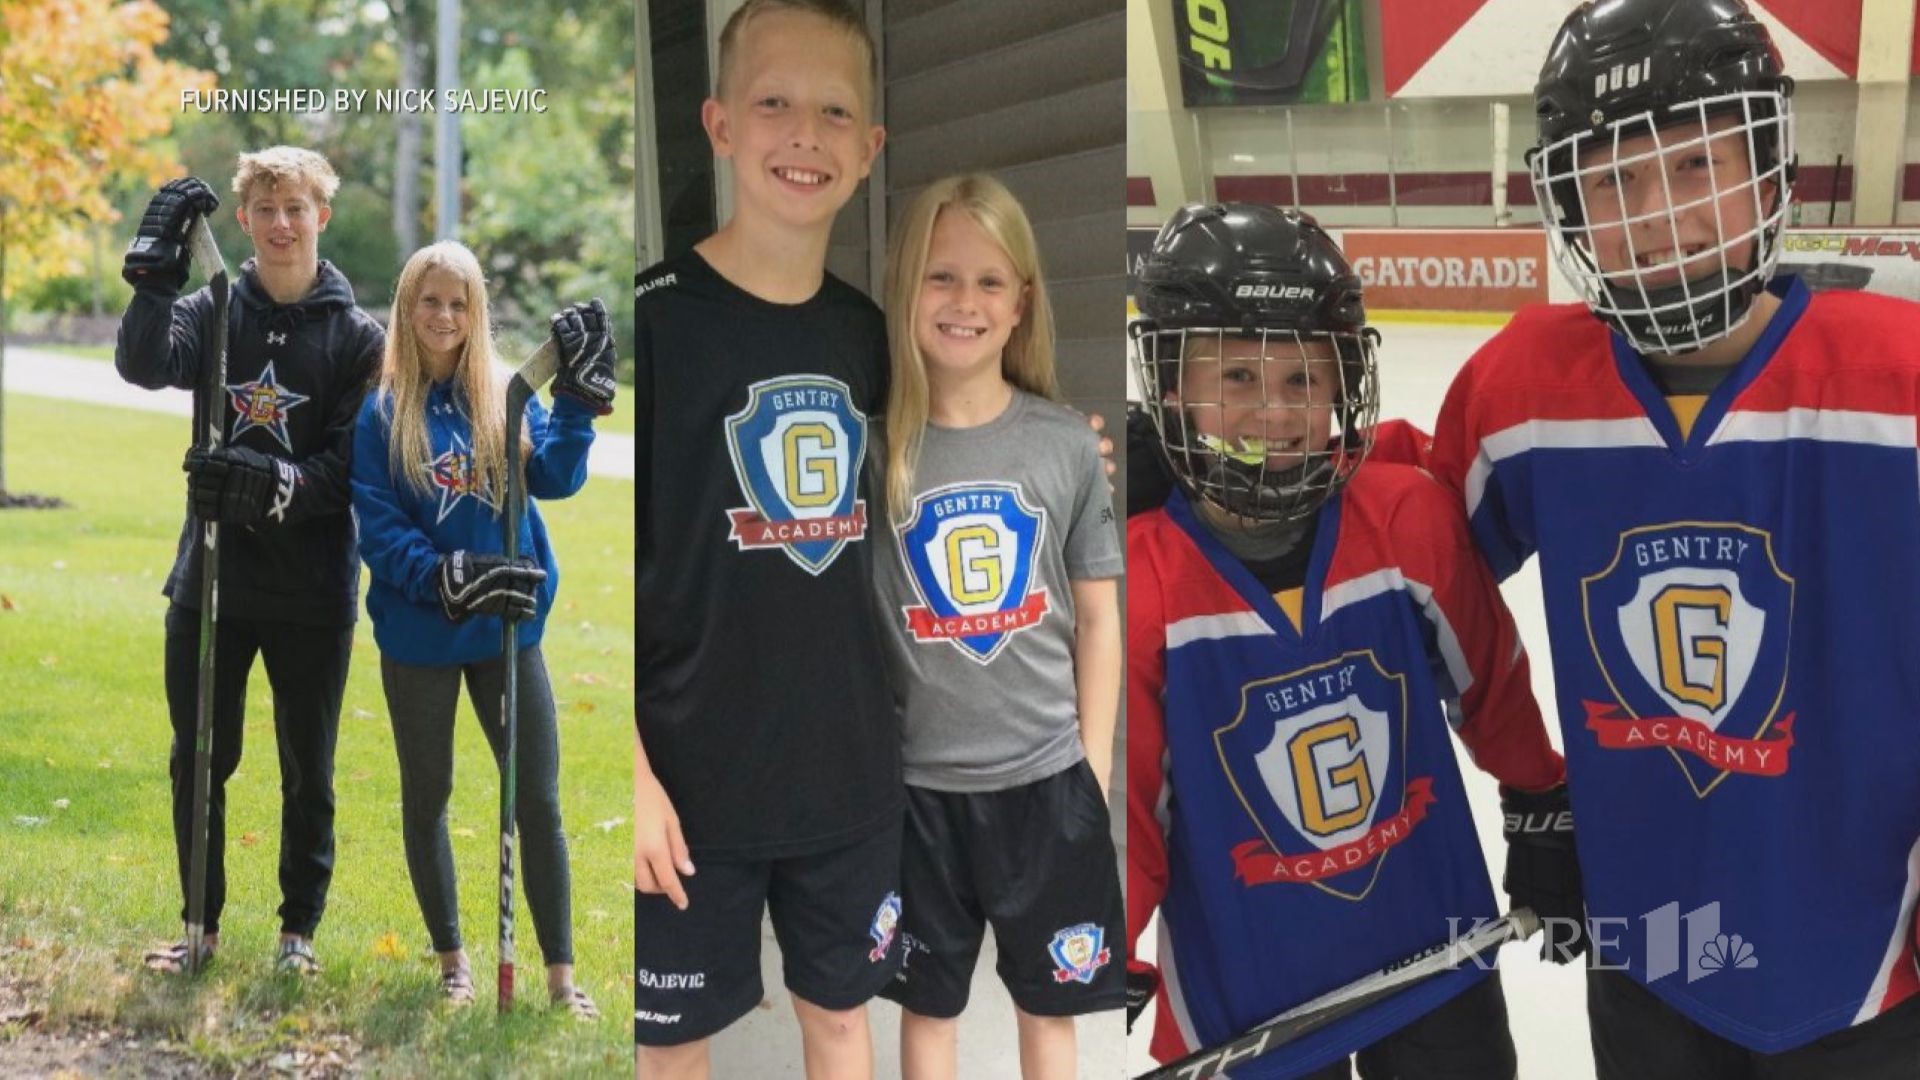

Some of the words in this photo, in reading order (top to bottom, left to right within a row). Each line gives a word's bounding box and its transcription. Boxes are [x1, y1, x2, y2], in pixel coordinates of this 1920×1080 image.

[1352, 256, 1538, 289] GATORADE
[1235, 284, 1316, 302] BAUER
[772, 389, 840, 411] GENTRY
[783, 421, 840, 509] G
[933, 494, 1003, 519] GENTRY
[944, 523, 1004, 606] G
[1634, 535, 1749, 567] GENTRY
[931, 610, 1030, 635] ACADEMY
[1649, 583, 1733, 715] G
[1626, 722, 1772, 769] ACADEMY
[1285, 712, 1376, 838] G
[1503, 811, 1575, 832] AUE
[1272, 813, 1410, 877] ACADEMY
[639, 968, 705, 989] SAJEVIC
